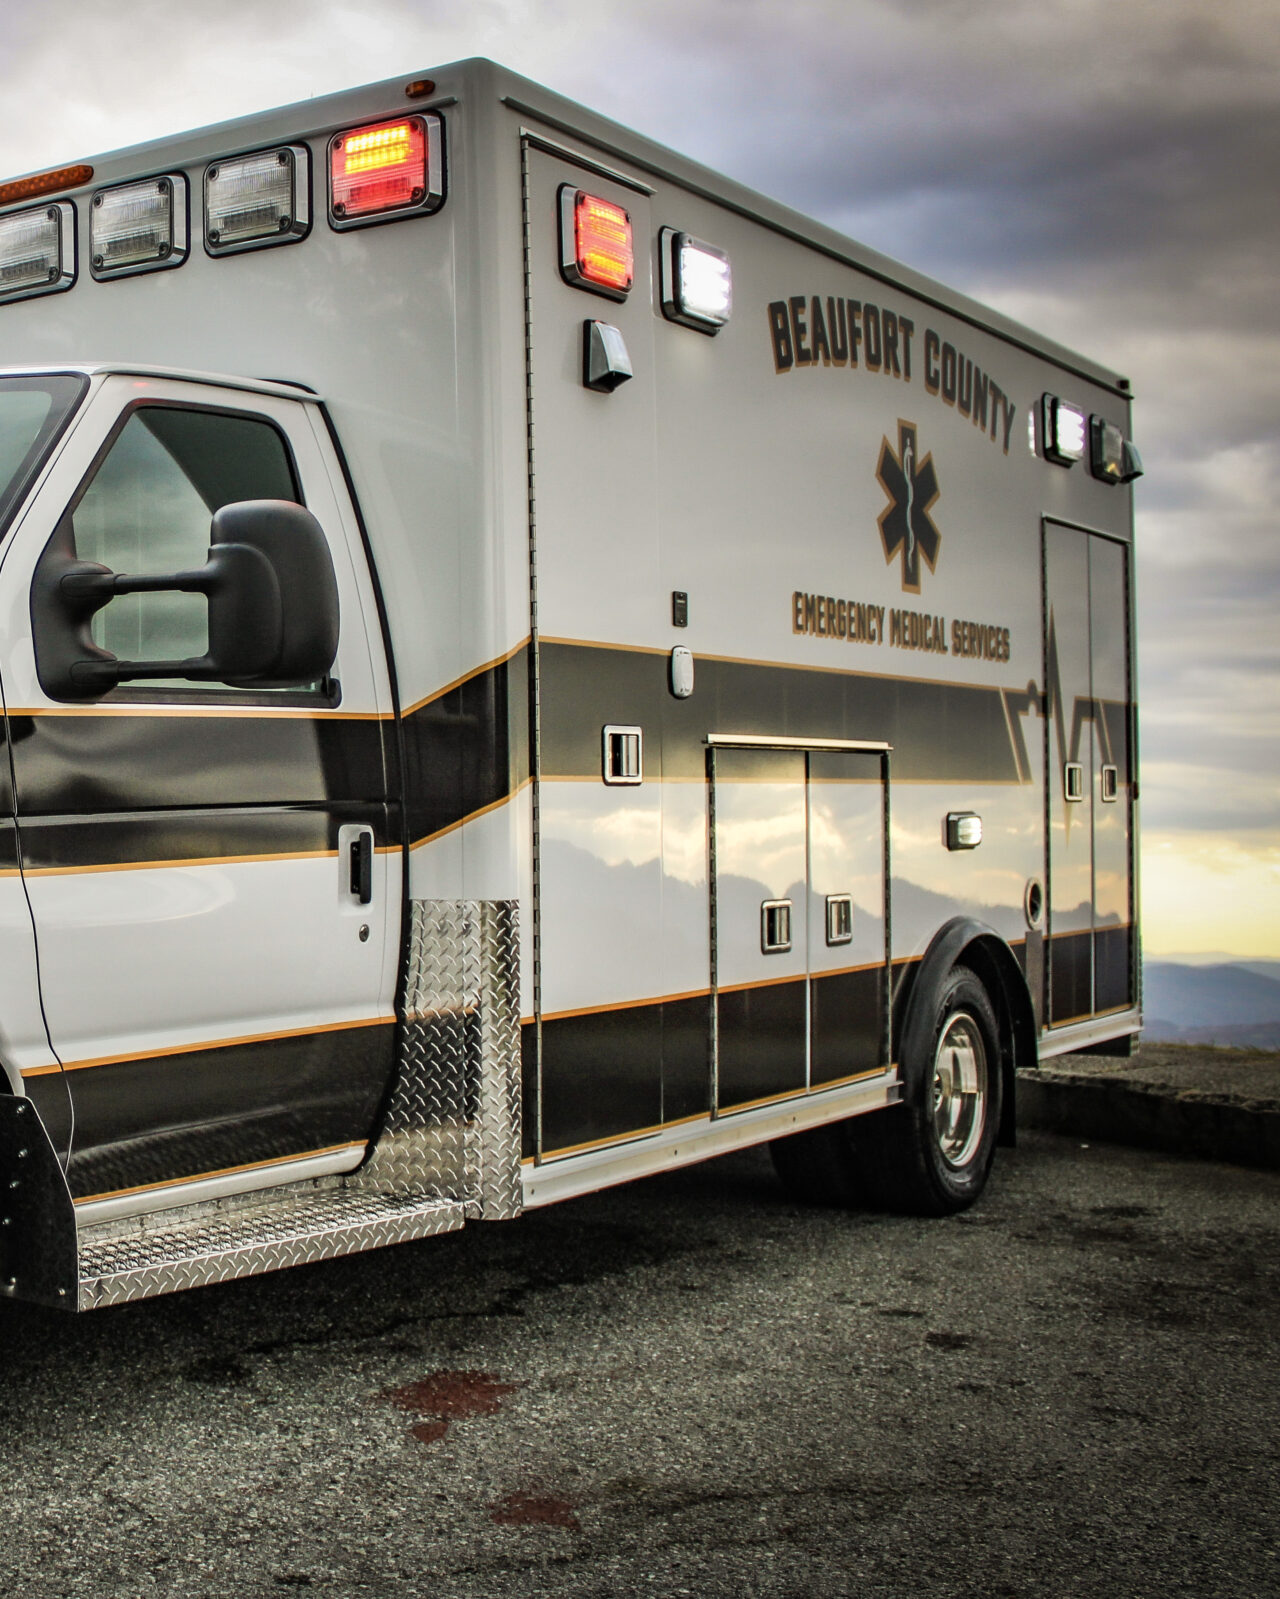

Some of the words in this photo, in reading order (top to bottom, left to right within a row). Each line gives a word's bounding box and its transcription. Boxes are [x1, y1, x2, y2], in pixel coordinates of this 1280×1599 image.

[768, 295, 914, 383] BEAUFORT
[924, 328, 1016, 456] COUNTY
[792, 591, 885, 646] EMERGENCY
[889, 608, 948, 655] MEDICAL
[951, 619, 1010, 663] SERVICES
